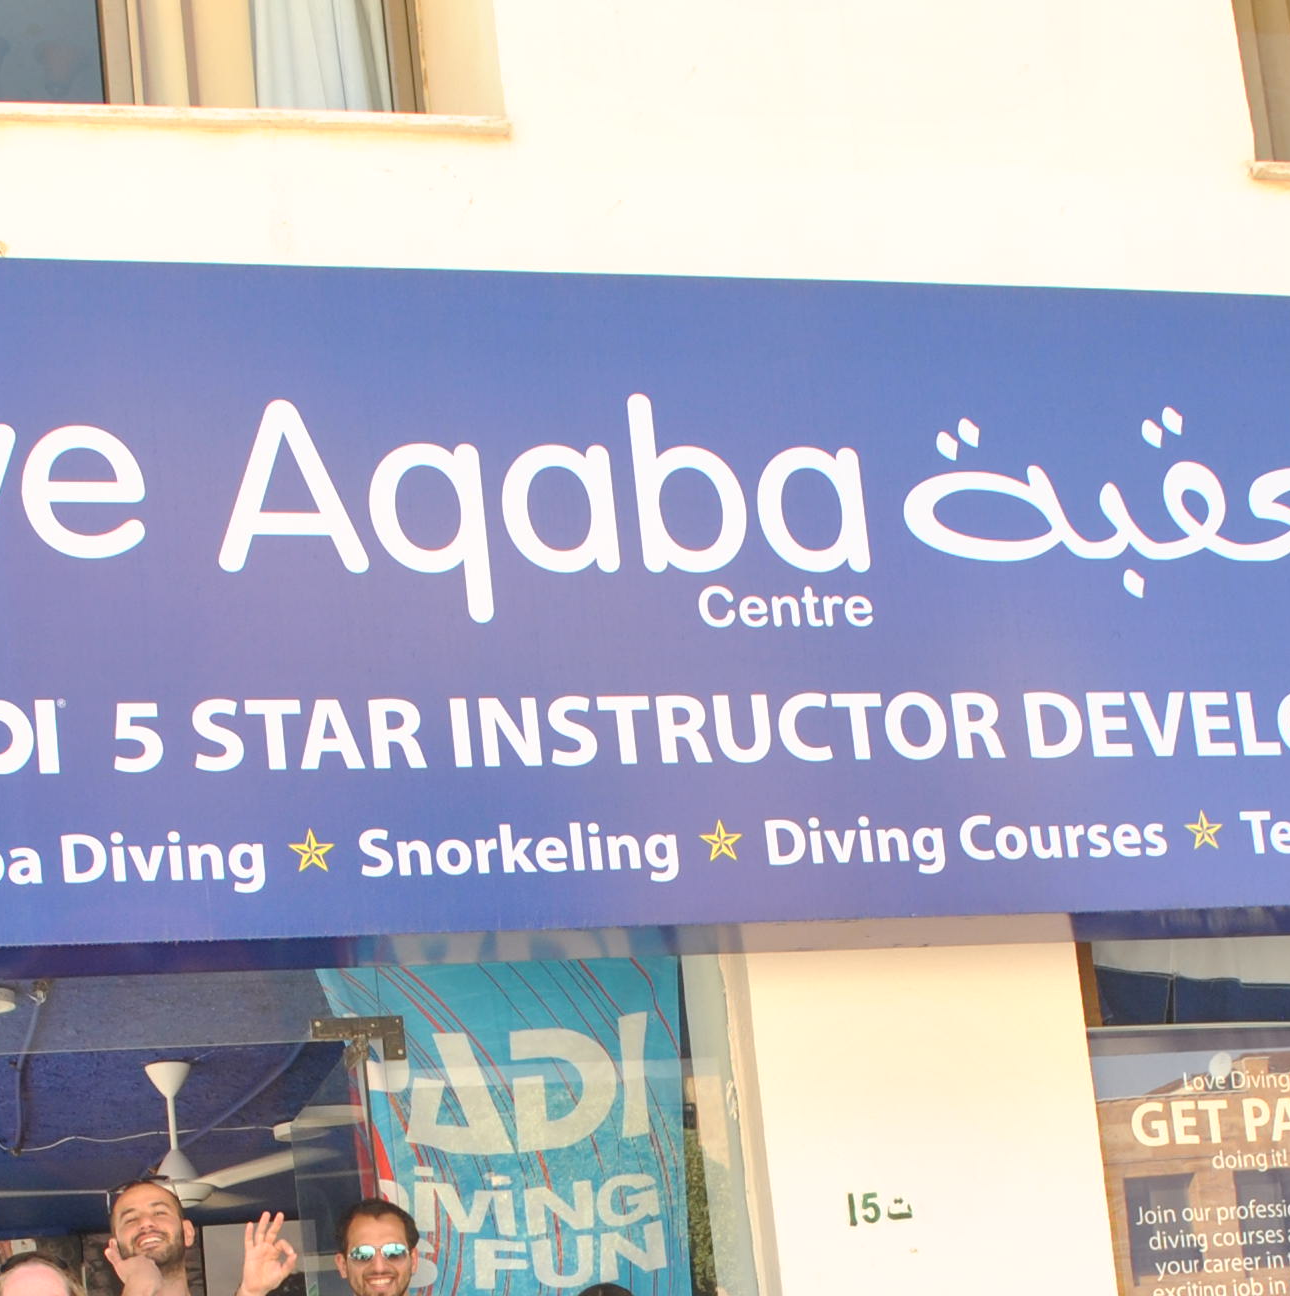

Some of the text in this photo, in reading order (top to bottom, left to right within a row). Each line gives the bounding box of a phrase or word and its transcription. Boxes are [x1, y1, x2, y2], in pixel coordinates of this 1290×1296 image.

[218, 392, 873, 624] Aqaba
[698, 585, 873, 627] Centre
[114, 702, 164, 773] 5
[192, 698, 427, 771] STAR
[449, 692, 1006, 767] INSTRUCTOR
[60, 831, 266, 893] Diving
[358, 822, 679, 882] Snorkeling
[764, 815, 1168, 874] Diving Courses
[1183, 1072, 1226, 1092] Love
[1130, 1100, 1229, 1147] GET
[1212, 1150, 1288, 1172] doing it!
[1136, 1206, 1176, 1226] Join
[1182, 1207, 1210, 1223] our
[474, 1220, 667, 1290] FUN
[1149, 1230, 1207, 1252] diving
[1213, 1227, 1284, 1246] courses
[1155, 1257, 1199, 1281] your
[1203, 1254, 1262, 1274] career
[1266, 1252, 1283, 1270] in
[1268, 1276, 1285, 1295] in
